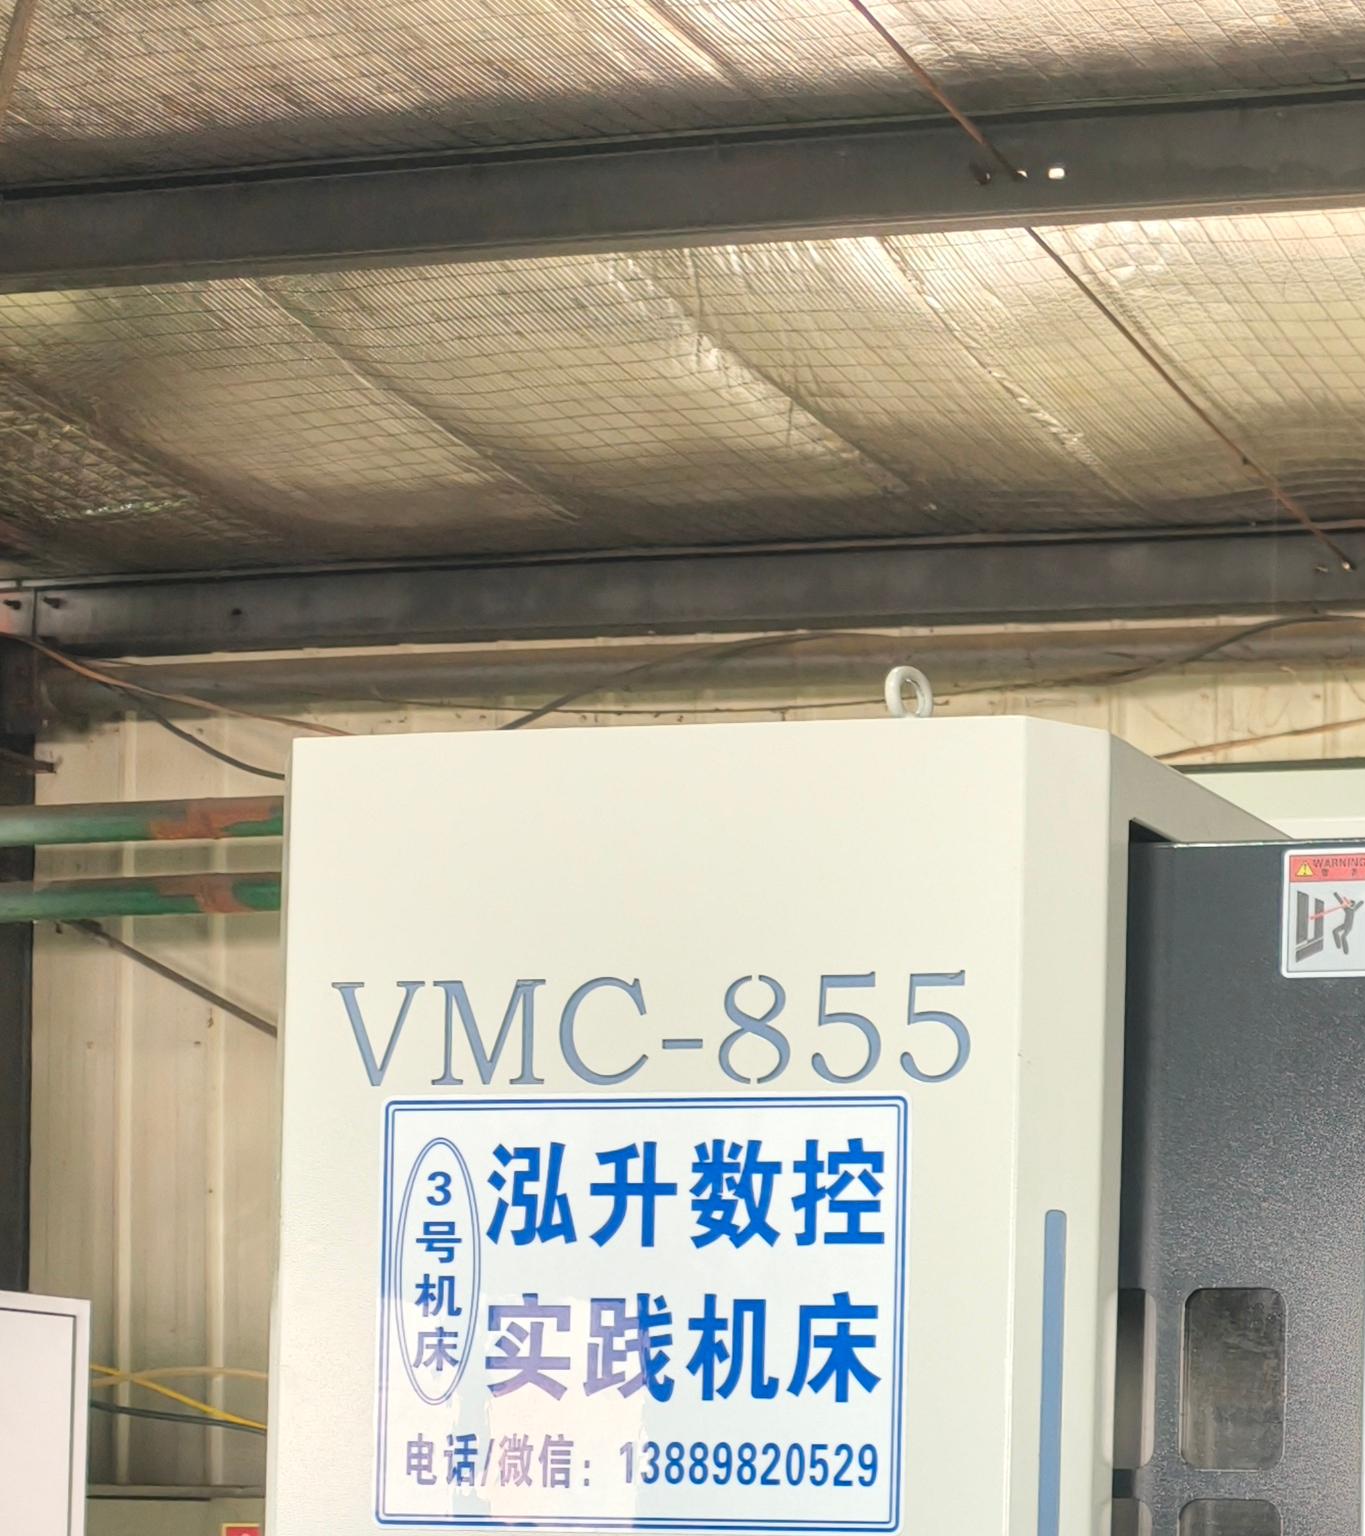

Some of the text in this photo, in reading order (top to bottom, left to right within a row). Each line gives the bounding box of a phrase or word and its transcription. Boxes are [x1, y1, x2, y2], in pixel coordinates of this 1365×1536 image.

[332, 970, 971, 1087] VMC-855
[486, 1137, 886, 1250] 泓升数控
[410, 1170, 463, 1373] 3号机床
[484, 1292, 882, 1404] 实践机床
